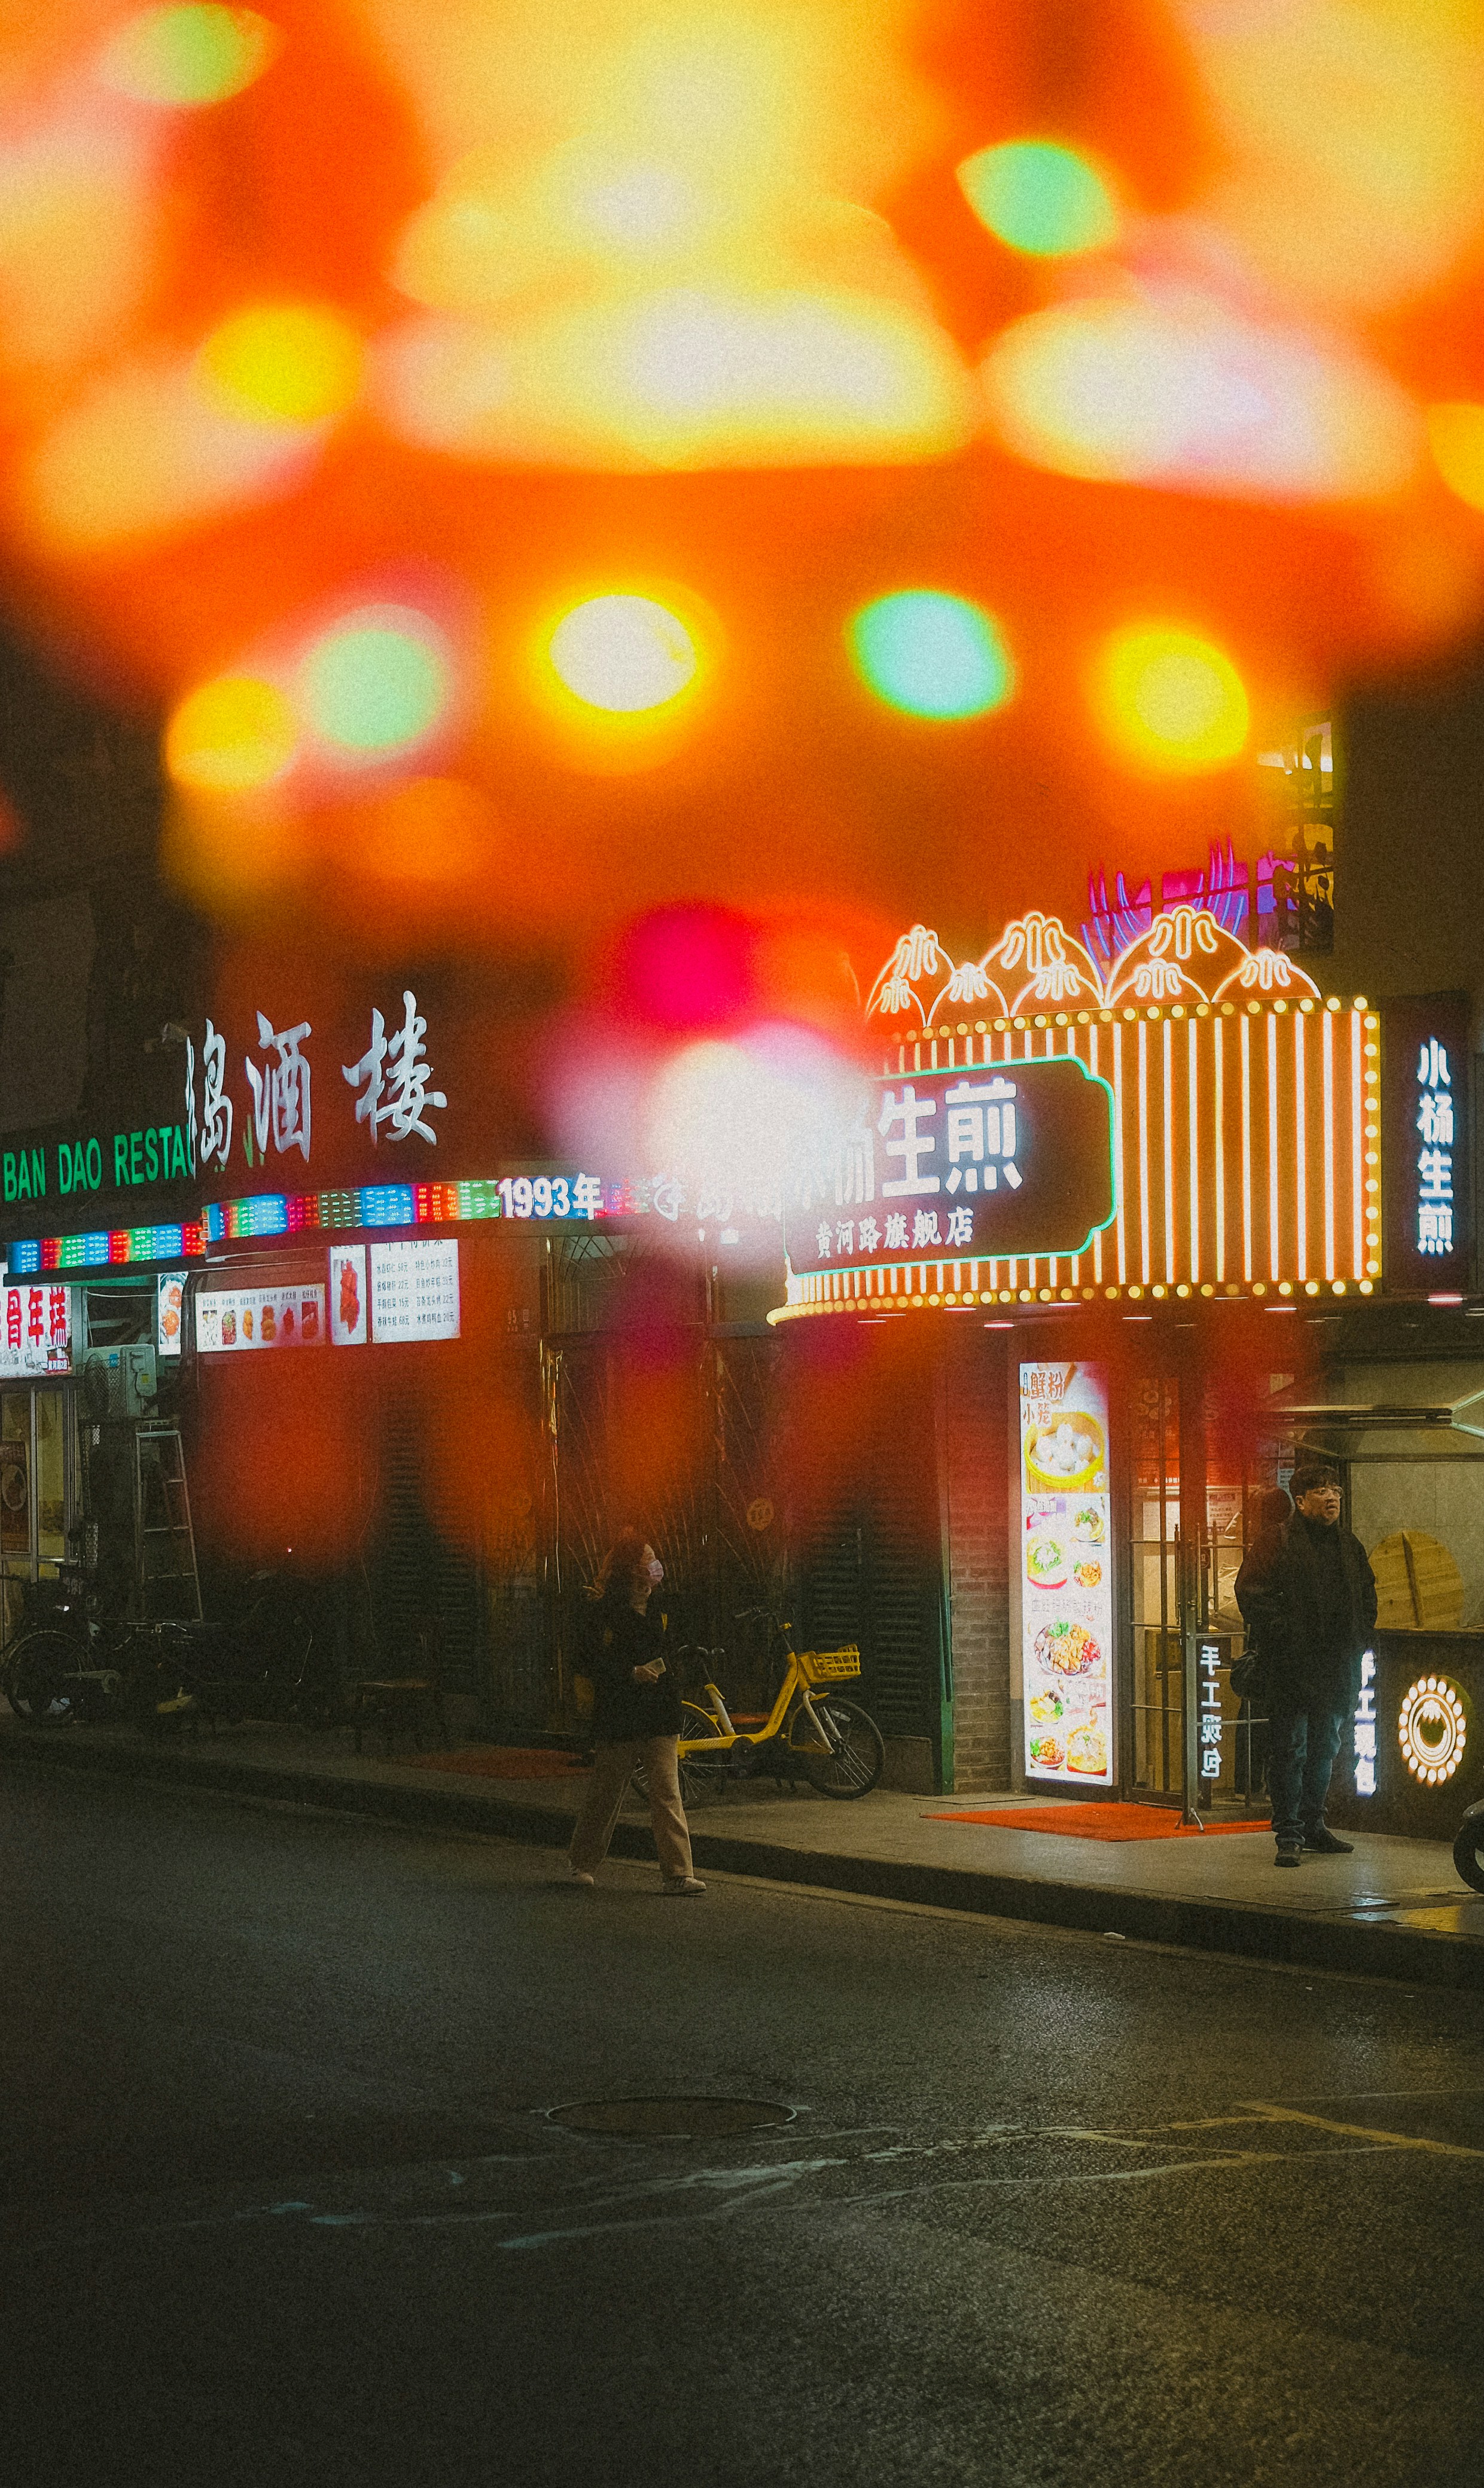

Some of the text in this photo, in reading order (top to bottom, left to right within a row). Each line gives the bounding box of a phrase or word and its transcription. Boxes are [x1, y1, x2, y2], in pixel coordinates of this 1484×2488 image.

[3, 1147, 46, 1202] BAN
[58, 1137, 102, 1195] DAO
[1417, 1037, 1454, 1253] 小杨生煎
[498, 1172, 604, 1220] 1993年
[816, 1207, 974, 1259] 黄河路旗舰店
[0, 1286, 68, 1350] 骨年糕
[1030, 1372, 1065, 1400] 蟹粉
[1023, 1403, 1051, 1426] 小笼
